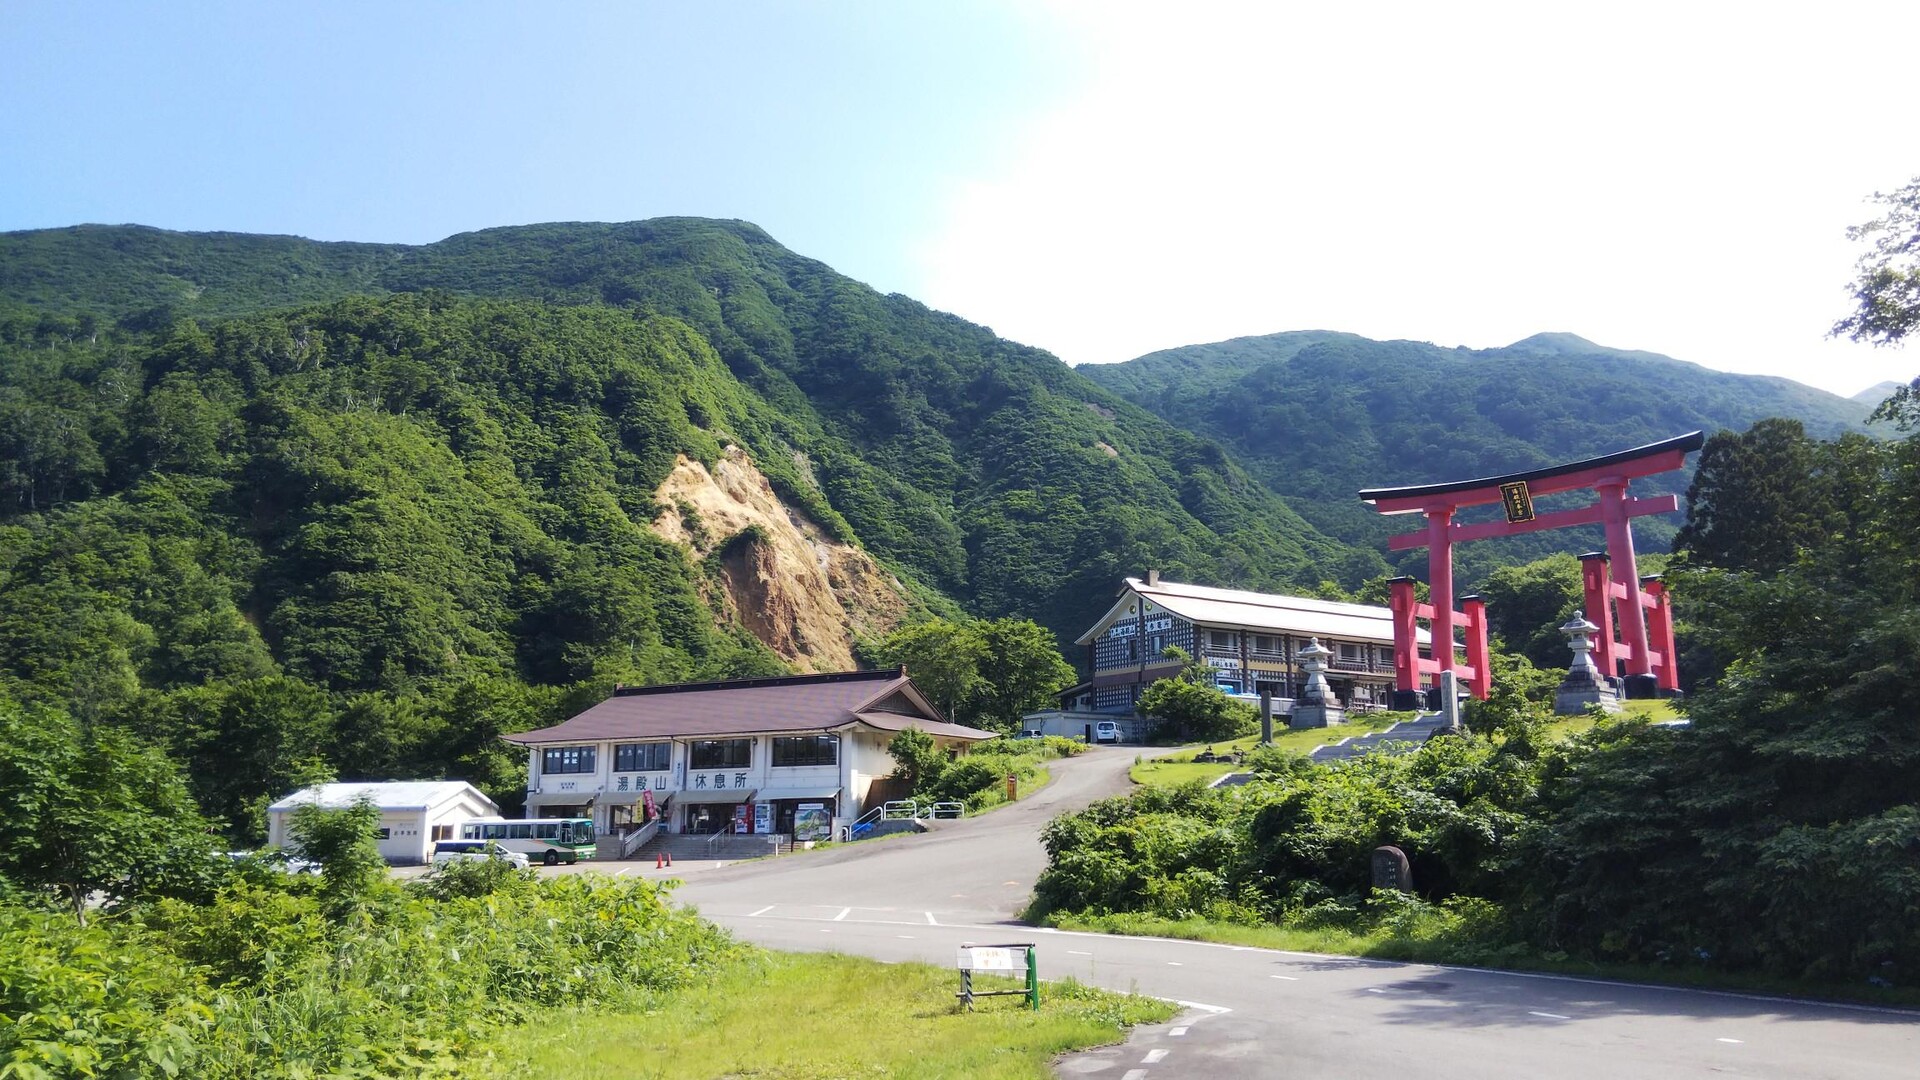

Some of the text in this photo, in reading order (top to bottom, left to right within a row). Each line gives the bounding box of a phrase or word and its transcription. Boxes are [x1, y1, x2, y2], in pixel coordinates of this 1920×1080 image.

[617, 775, 667, 792] 湯殿山
[694, 772, 747, 789] 休息所
